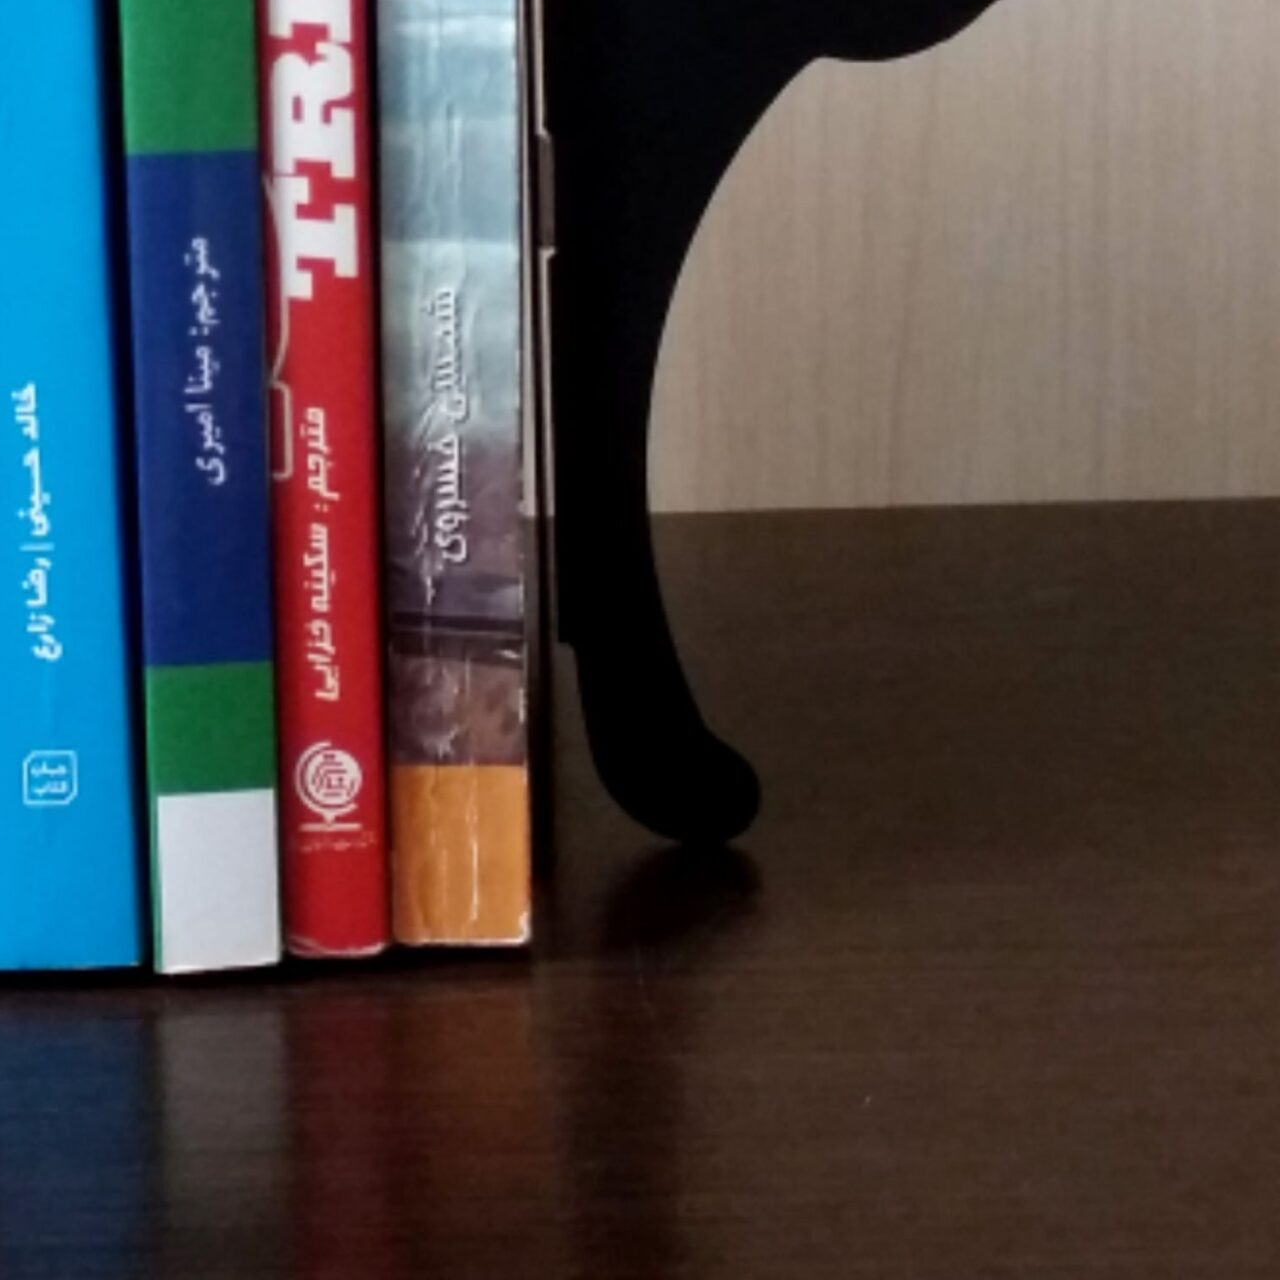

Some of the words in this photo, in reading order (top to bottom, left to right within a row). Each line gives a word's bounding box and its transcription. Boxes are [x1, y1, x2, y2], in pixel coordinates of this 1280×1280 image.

[183, 236, 220, 337] مترجم:
[183, 346, 220, 394] مینا
[11, 382, 38, 440] خالد
[184, 404, 227, 487] امیری
[17, 447, 51, 537] حسینی
[20, 558, 51, 607] رضا
[303, 522, 336, 613] سکینه
[25, 614, 62, 662] زارع
